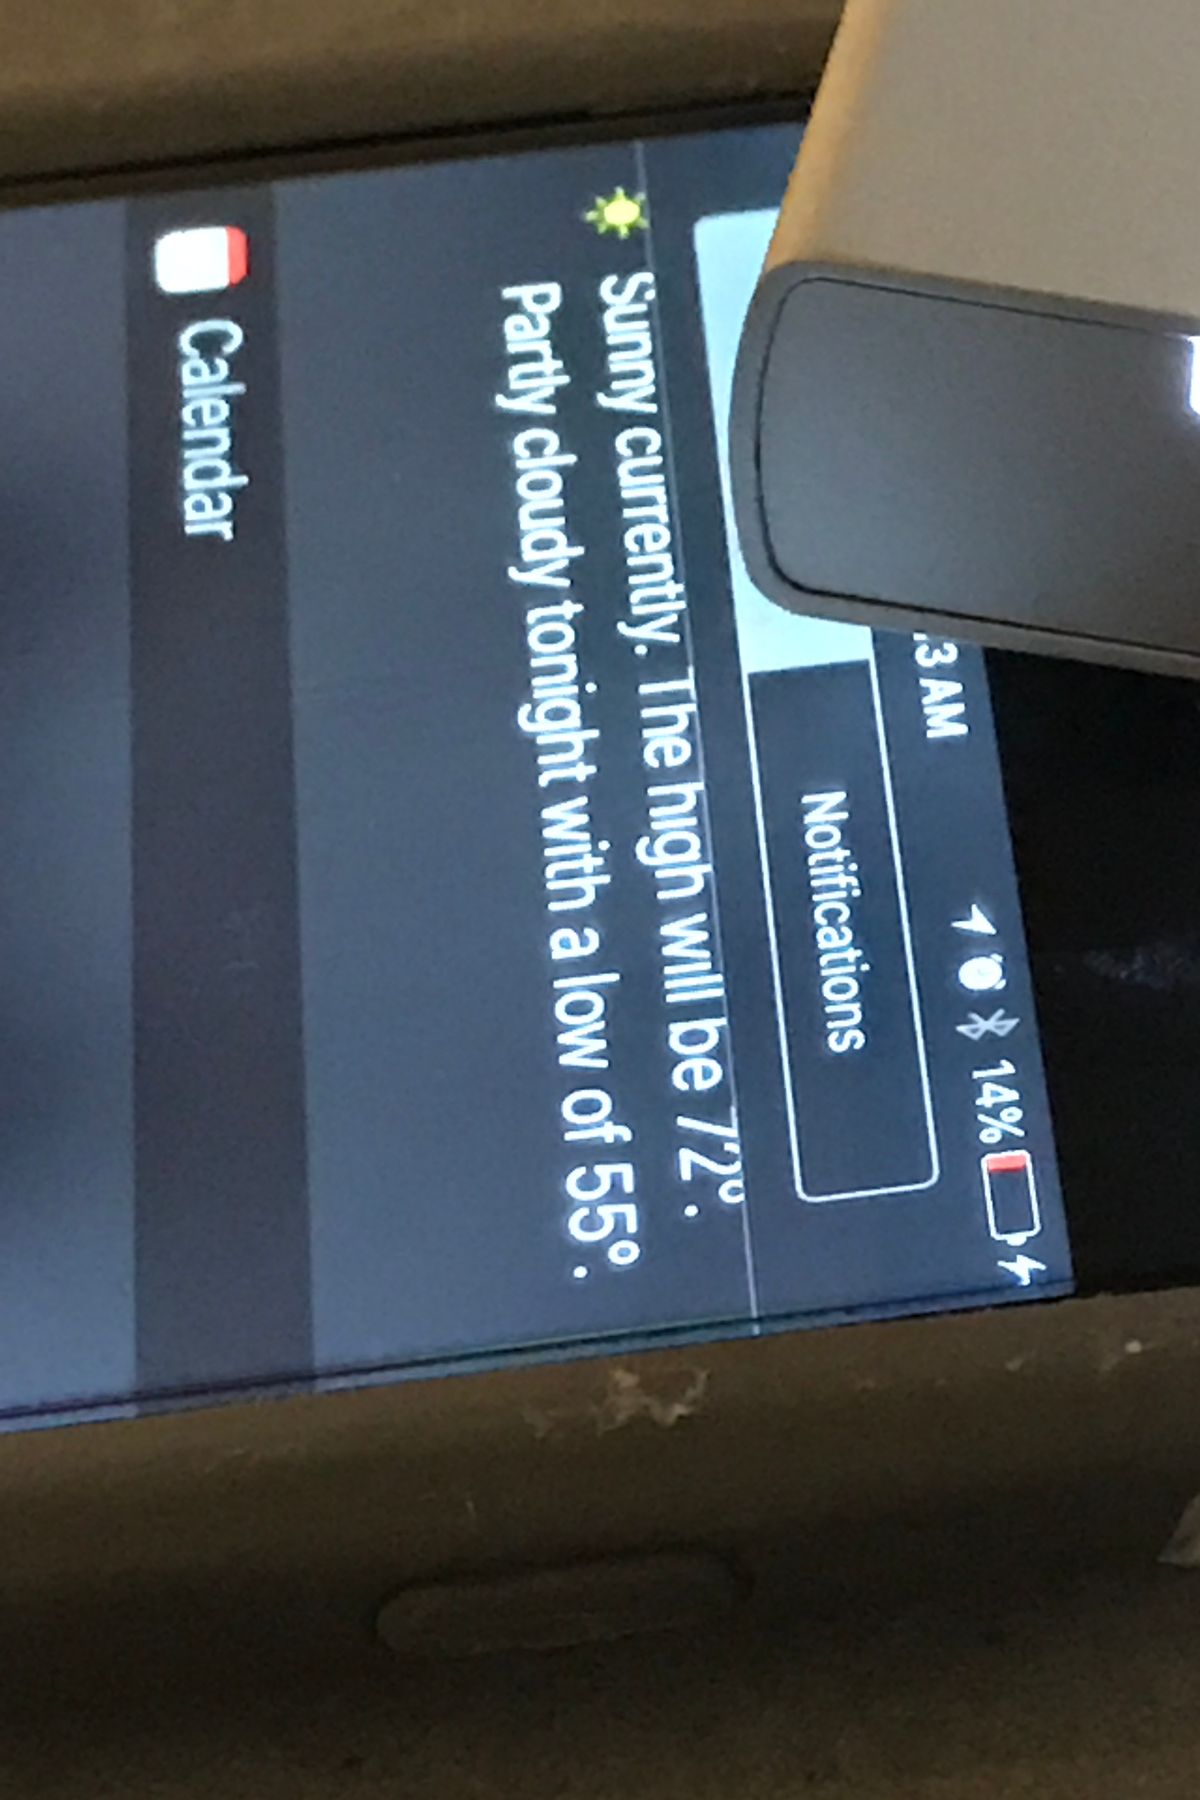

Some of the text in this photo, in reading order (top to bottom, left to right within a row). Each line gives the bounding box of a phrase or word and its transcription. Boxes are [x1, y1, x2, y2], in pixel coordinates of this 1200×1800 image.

[496, 282, 570, 415] Partly
[598, 270, 658, 414] Sunny
[178, 318, 249, 542] Calendar
[508, 427, 584, 590] cloudy
[615, 427, 687, 656] currently.
[517, 600, 599, 788] tonight
[637, 667, 698, 769] The
[919, 677, 969, 738] AM
[540, 796, 612, 912] with
[635, 781, 714, 899] high
[548, 927, 600, 960] a
[660, 912, 726, 1003] will
[801, 790, 869, 1054] Notifications
[552, 972, 620, 1069] low
[667, 1016, 729, 1092] be
[560, 1089, 633, 1142] of
[971, 1060, 1026, 1145] 14%
